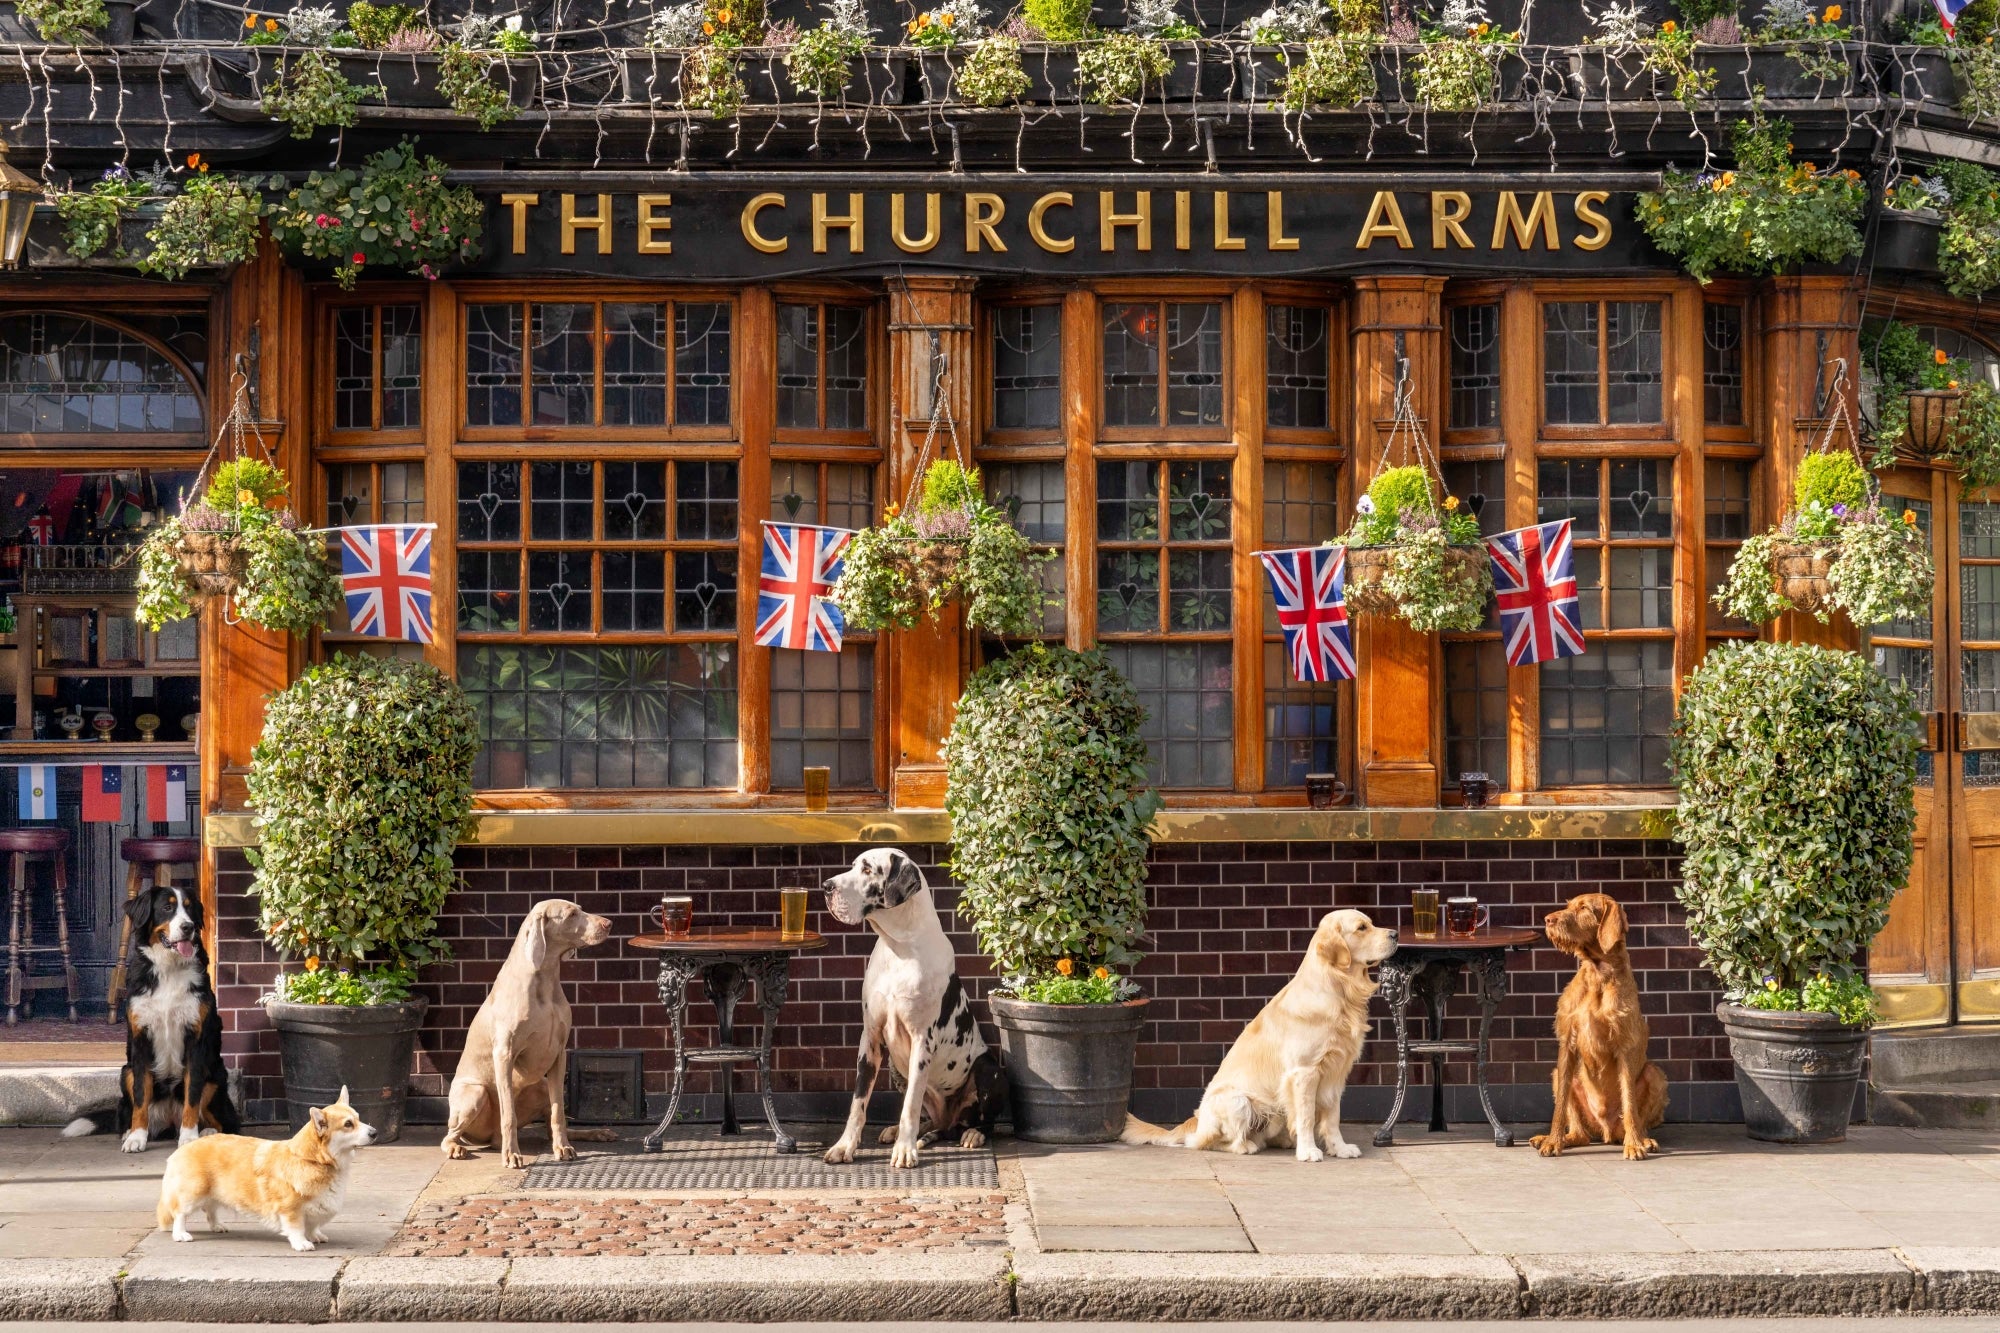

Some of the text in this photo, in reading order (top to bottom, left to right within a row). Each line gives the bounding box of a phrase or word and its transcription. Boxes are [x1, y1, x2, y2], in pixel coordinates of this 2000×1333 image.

[502, 191, 1611, 253] THE CHURCHILL ARMS
